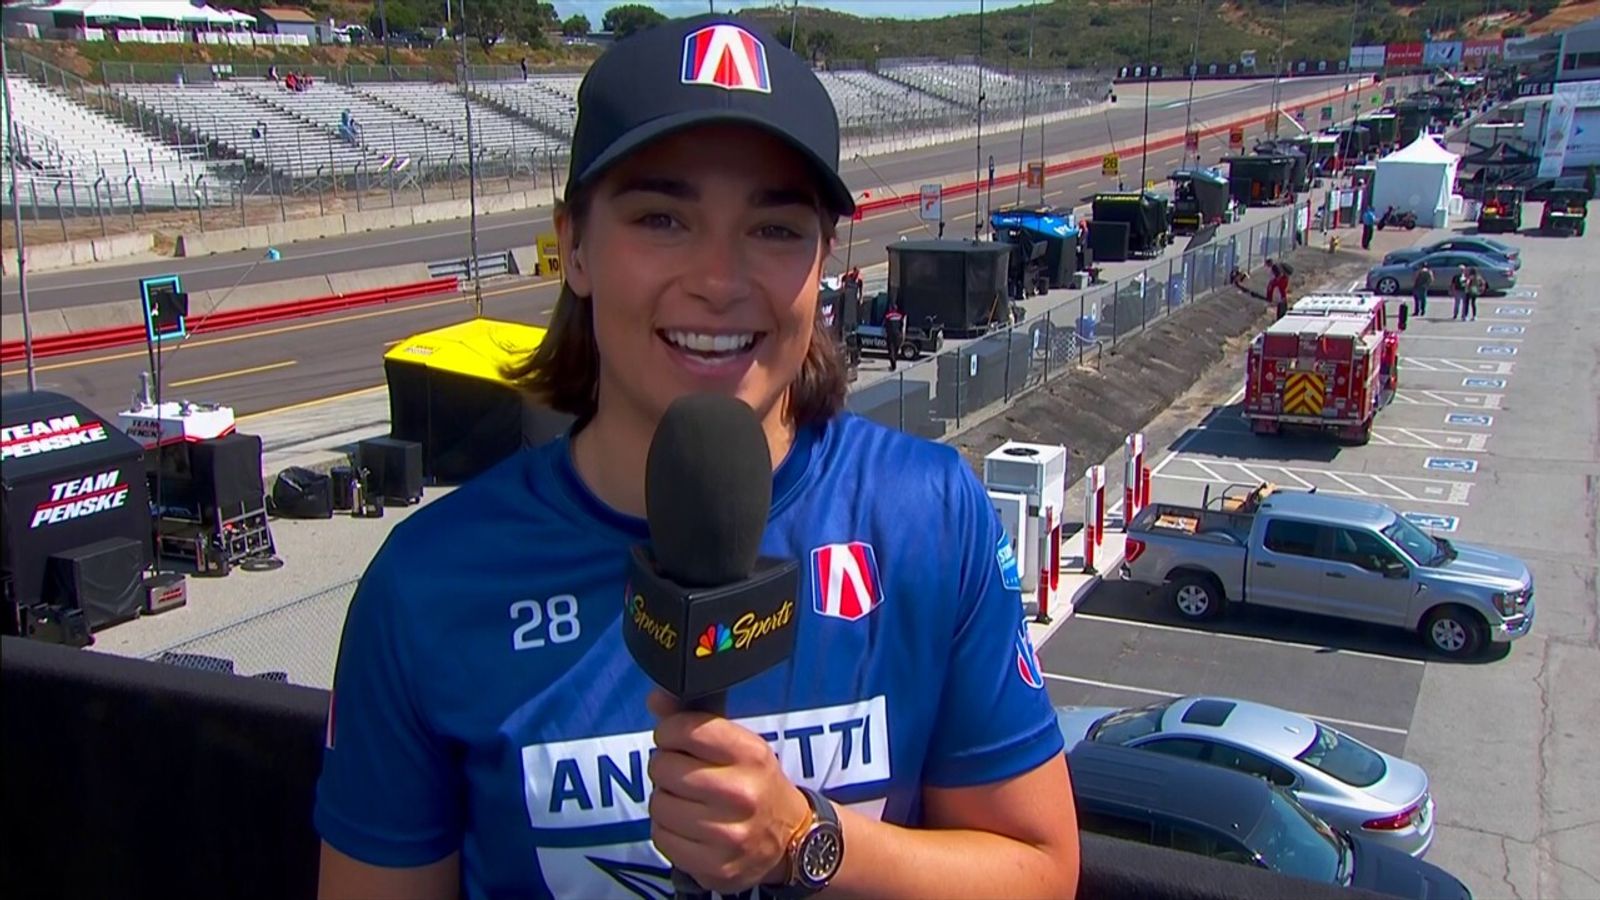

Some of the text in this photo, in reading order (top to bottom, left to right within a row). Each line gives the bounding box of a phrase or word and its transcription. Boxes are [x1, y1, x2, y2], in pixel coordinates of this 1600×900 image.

[1519, 83, 1539, 94] LIFE
[1, 415, 80, 441] TEAM
[51, 470, 119, 501] TEAM
[31, 489, 128, 528] PENSKE
[509, 594, 581, 650] 28
[633, 594, 678, 649] Sports
[733, 600, 793, 650] Sports
[549, 715, 872, 813] ANTTI
